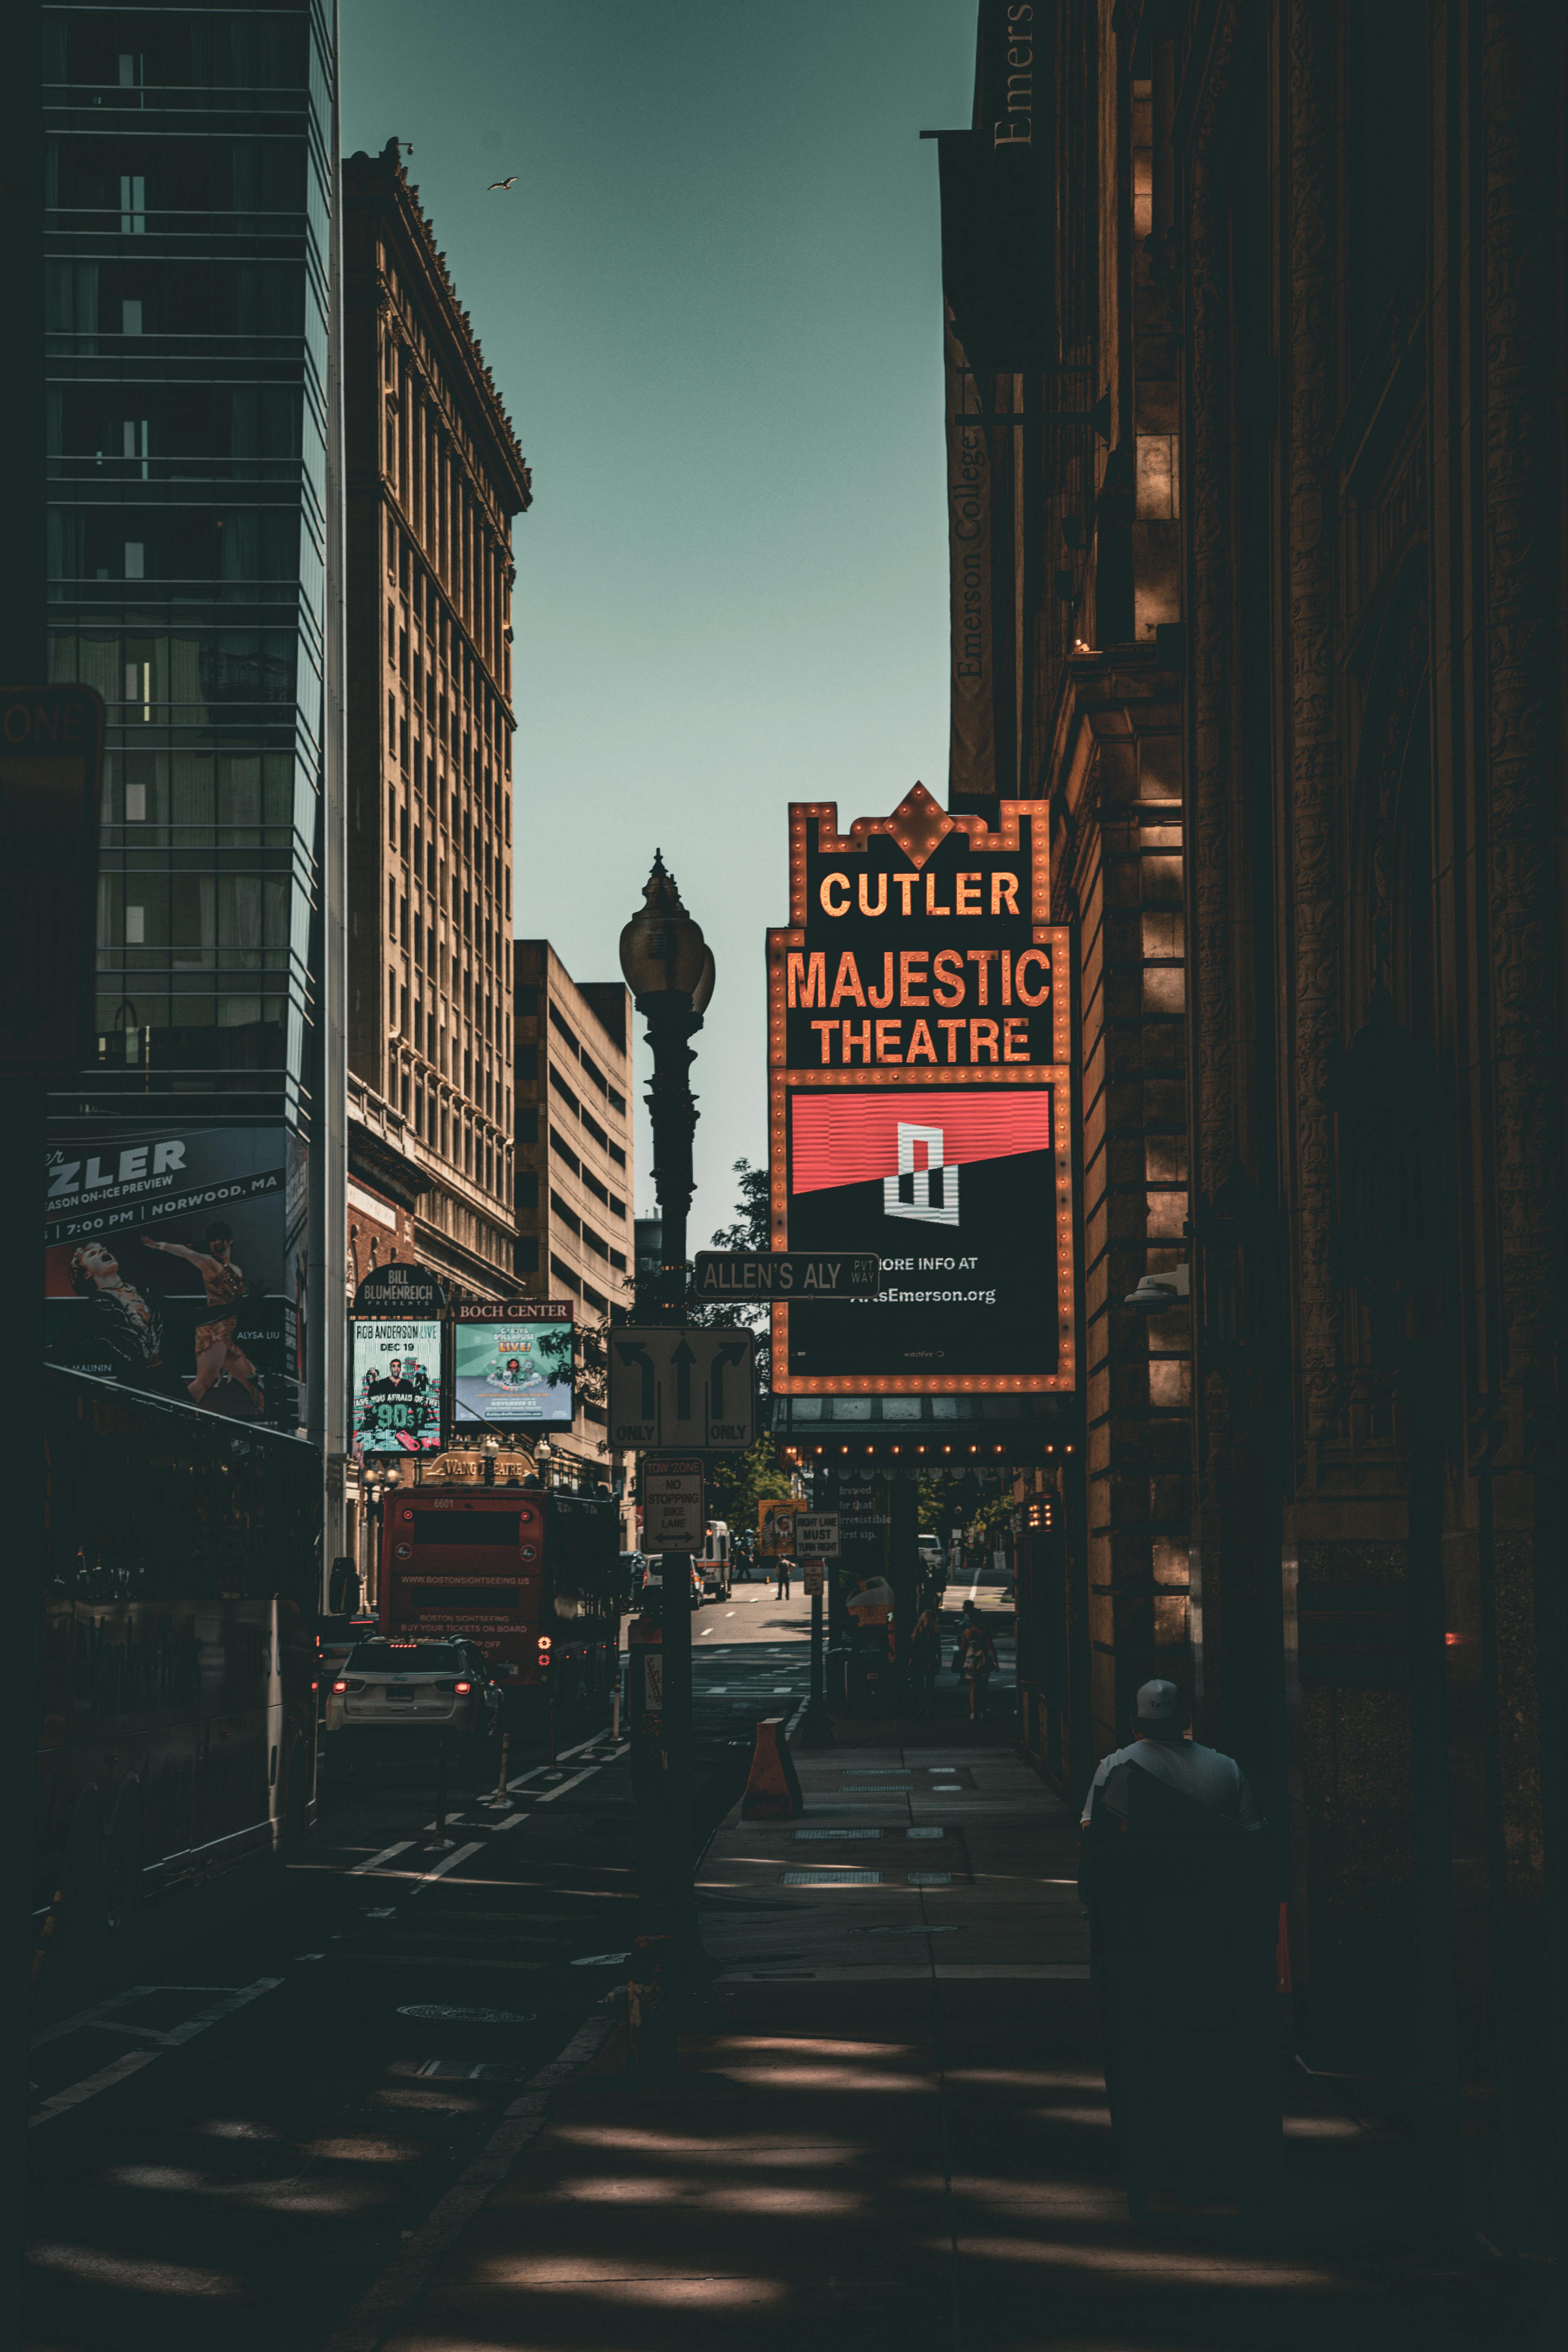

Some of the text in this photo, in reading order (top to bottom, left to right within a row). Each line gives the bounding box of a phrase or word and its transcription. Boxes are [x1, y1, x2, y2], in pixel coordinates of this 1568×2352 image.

[953, 433, 985, 680] Emerson College
[0, 703, 83, 744] ONE
[819, 871, 1021, 917] CUTLER
[787, 949, 1051, 1009] MAJESTIC
[810, 1018, 1031, 1064] THEATRE
[45, 1175, 173, 1211] ASON ON-ICE PREVIEW
[67, 1176, 277, 1234] 7:00 PM NORWOOD, MA
[854, 1260, 874, 1271] PVT
[919, 1258, 955, 1270] INFO
[958, 1257, 978, 1270] AT
[388, 1269, 409, 1284] BILL
[703, 1262, 841, 1289] ALLEN'S ALY
[851, 1272, 874, 1283] WAY
[364, 1285, 433, 1300] BLUMENREICH
[850, 1288, 996, 1304] sEmerson.org
[460, 1305, 568, 1318] BOCH CENTER
[375, 1326, 418, 1339] ANDERSON
[420, 1326, 436, 1339] LIVE
[499, 1342, 531, 1352] LIVE!
[356, 1398, 369, 1407] ARE
[425, 1397, 439, 1406] THE
[615, 1425, 655, 1441] ONLY
[710, 1424, 747, 1441] ONLY
[445, 1459, 522, 1476] WANG TEATRE
[647, 1462, 700, 1473] TOW ZONE
[666, 1479, 681, 1490] NO
[839, 1485, 871, 1495] Brewed
[648, 1493, 699, 1504] STOPPING
[663, 1507, 684, 1516] BIKE
[839, 1501, 873, 1510] for that
[662, 1519, 686, 1528] LANE
[798, 1517, 837, 1527] RIGHT LANE
[803, 1530, 831, 1540] MUST
[860, 1529, 877, 1540] sip.
[798, 1542, 838, 1552] TURN RIGHT
[401, 1576, 530, 1585] WWW.BOSTONSIGHTSEEING.US
